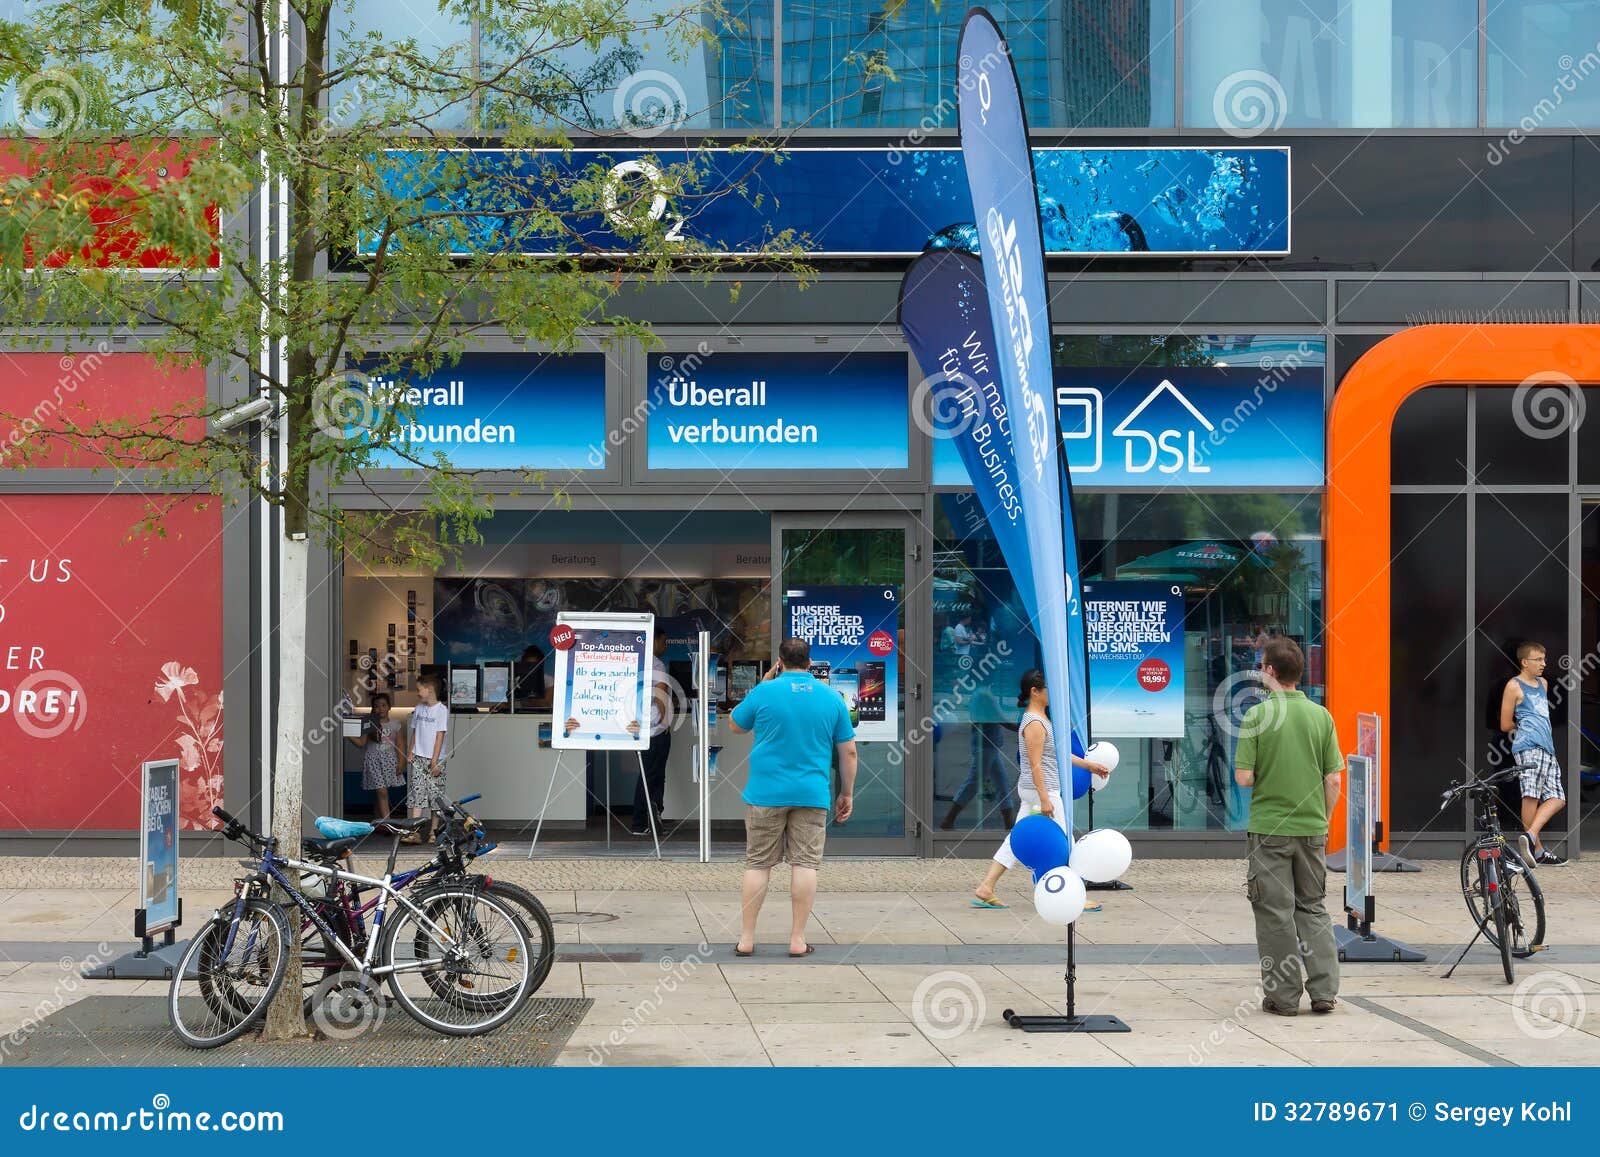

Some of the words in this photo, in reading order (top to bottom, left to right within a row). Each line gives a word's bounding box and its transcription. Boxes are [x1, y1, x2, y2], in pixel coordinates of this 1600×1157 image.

[962, 330, 989, 375] Wir
[668, 377, 766, 406] Überall
[667, 418, 817, 443] verbunden
[938, 348, 964, 382] für
[955, 386, 981, 420] Ihr
[971, 423, 1023, 527] Business.
[1113, 429, 1211, 473] DSL
[551, 555, 595, 567] Beratung
[29, 559, 72, 583] US
[791, 605, 841, 616] UNSERE
[1085, 601, 1140, 612] NTERNET
[1142, 601, 1167, 612] WIE
[791, 615, 863, 626] HIGHSPEED
[1100, 612, 1119, 622] ES
[1119, 612, 1166, 622] WILLST.
[791, 625, 865, 636] HIGHLIGHTS
[1087, 622, 1166, 632] NBEGRENZT
[553, 631, 572, 644] NEU
[818, 635, 839, 646] LTE
[840, 635, 862, 646] 4G.
[1087, 632, 1171, 643] ELEFONIEREN
[580, 642, 635, 652] Top-Angebot
[1110, 642, 1142, 653] SMS.
